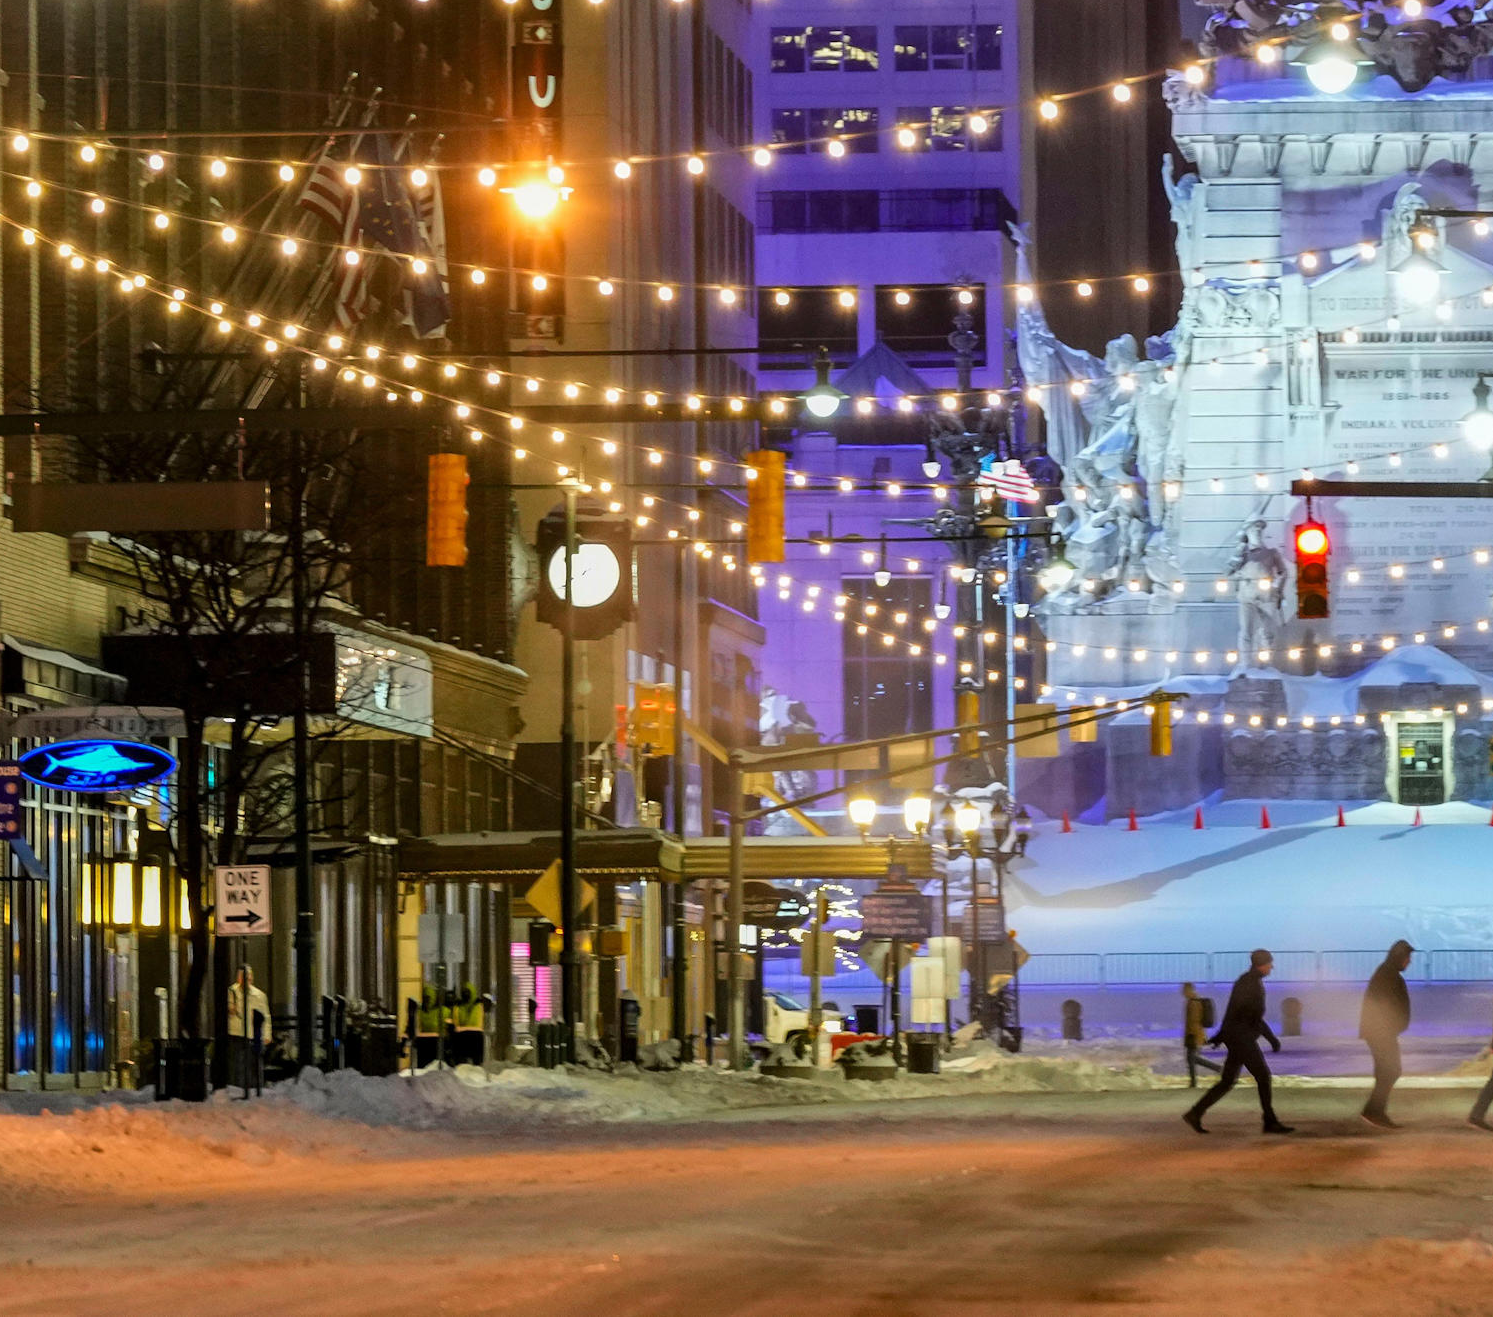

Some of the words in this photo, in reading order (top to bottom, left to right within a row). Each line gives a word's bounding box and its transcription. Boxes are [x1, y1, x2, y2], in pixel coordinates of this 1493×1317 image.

[1335, 369, 1369, 380] WAR
[1373, 369, 1406, 380] FOR
[225, 870, 260, 886] ONE
[225, 889, 262, 904] WAY
